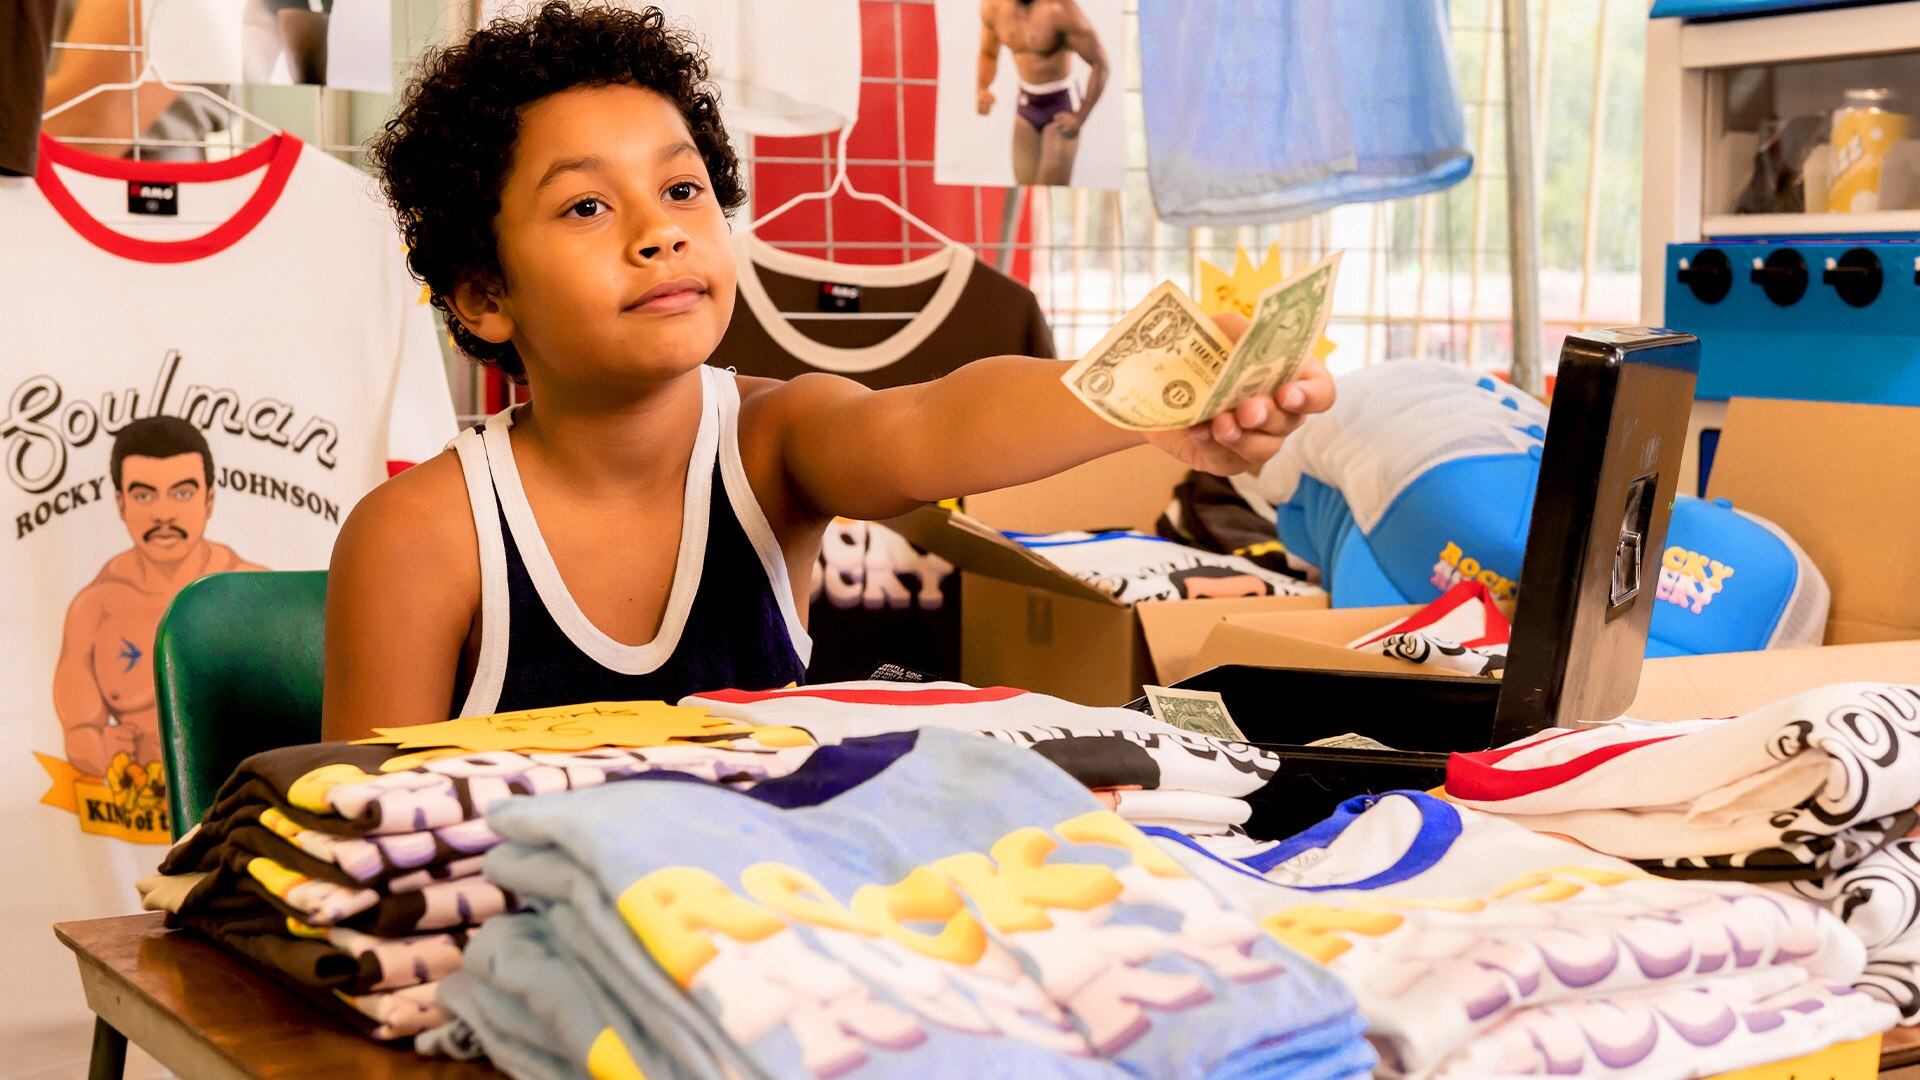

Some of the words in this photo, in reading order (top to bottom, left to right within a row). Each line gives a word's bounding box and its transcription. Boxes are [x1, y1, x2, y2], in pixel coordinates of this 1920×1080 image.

[0, 348, 338, 494] Soulman
[16, 476, 105, 540] ROCKY
[217, 466, 340, 525] JOHNSON
